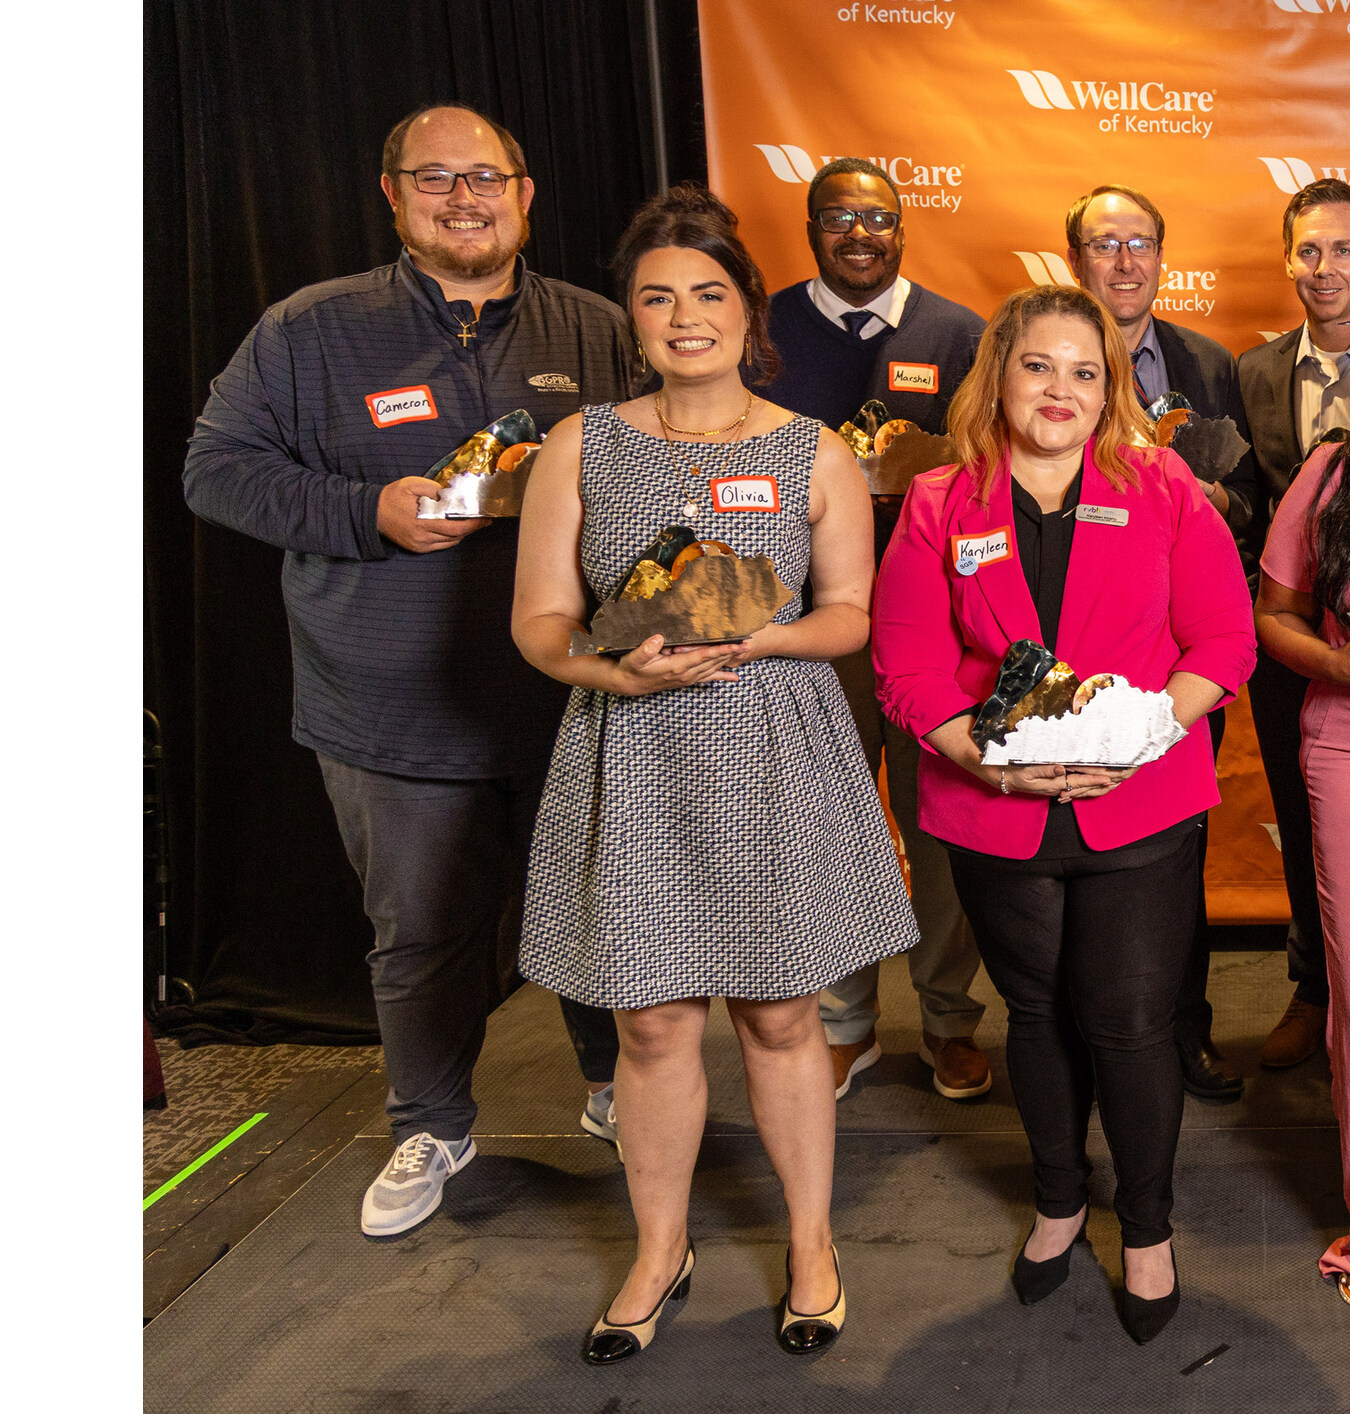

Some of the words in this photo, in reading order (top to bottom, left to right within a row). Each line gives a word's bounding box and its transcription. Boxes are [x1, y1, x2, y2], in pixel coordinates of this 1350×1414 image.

[837, 3, 860, 21] of
[865, 4, 955, 30] Kentucky
[1071, 81, 1214, 112] WellCare
[1099, 113, 1121, 132] of
[1125, 114, 1213, 139] Kentucky
[900, 190, 962, 213] ntucky
[1152, 293, 1215, 316] ntucky
[376, 400, 431, 415] Cameron
[722, 486, 768, 504] Olivia
[961, 540, 1008, 559] Karyleen
